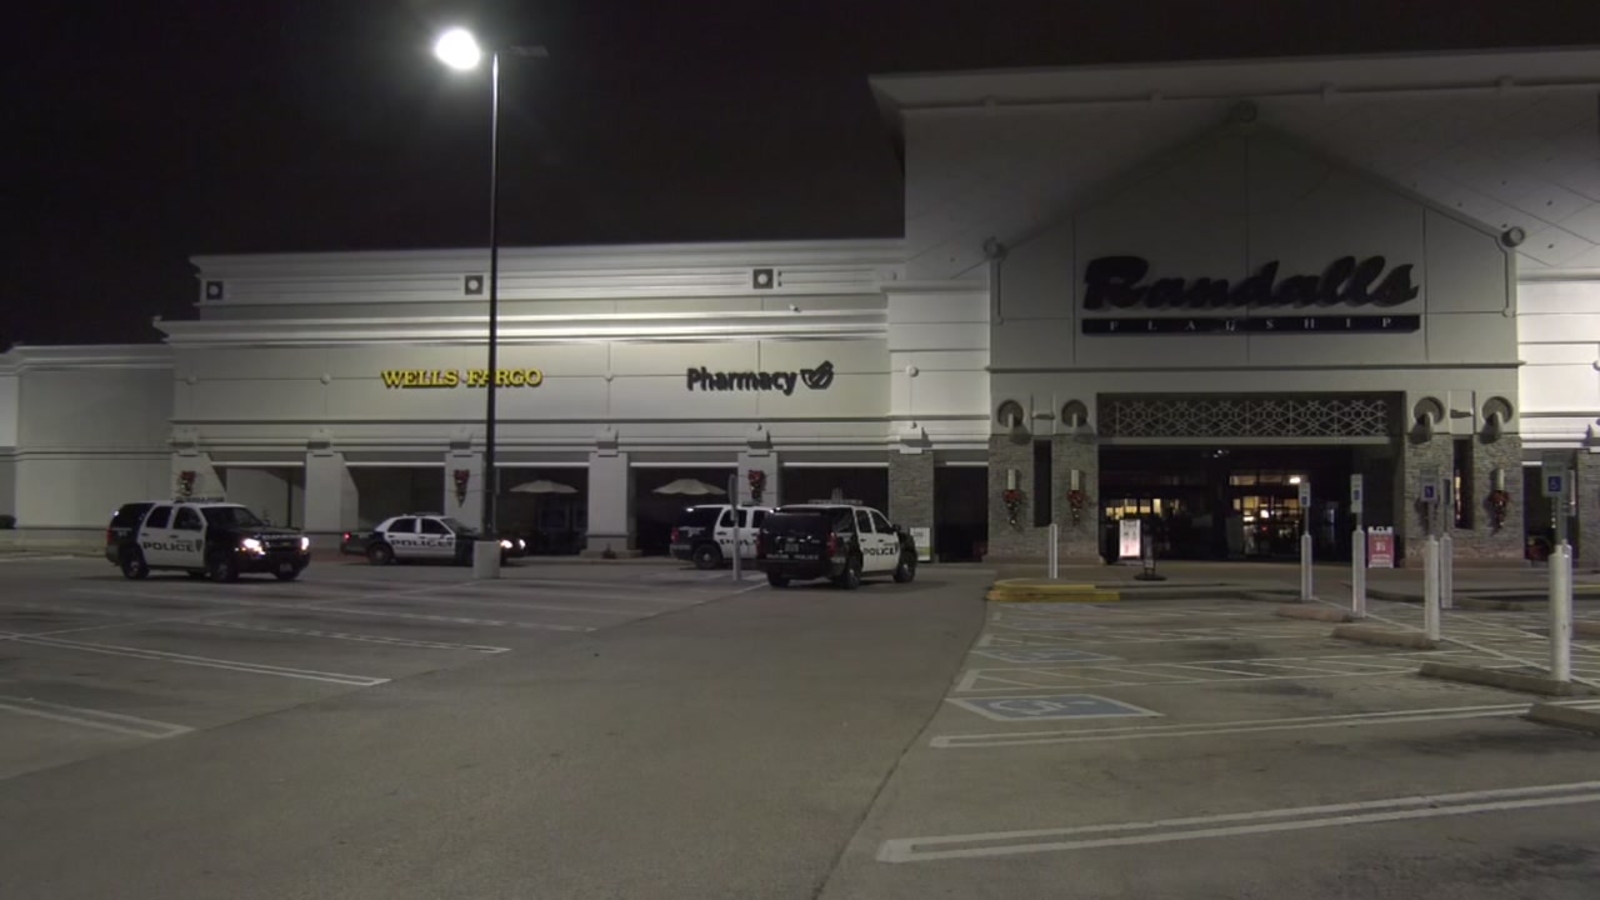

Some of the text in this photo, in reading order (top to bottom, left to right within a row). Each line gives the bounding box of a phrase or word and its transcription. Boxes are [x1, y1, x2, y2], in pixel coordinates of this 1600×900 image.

[1083, 255, 1420, 310] Randalls
[1108, 316, 1392, 332] FLAGSHIP
[381, 369, 459, 388] WELLS
[686, 366, 798, 396] Pharmacy
[143, 541, 194, 552] POLICE
[862, 547, 894, 556] POLICE
